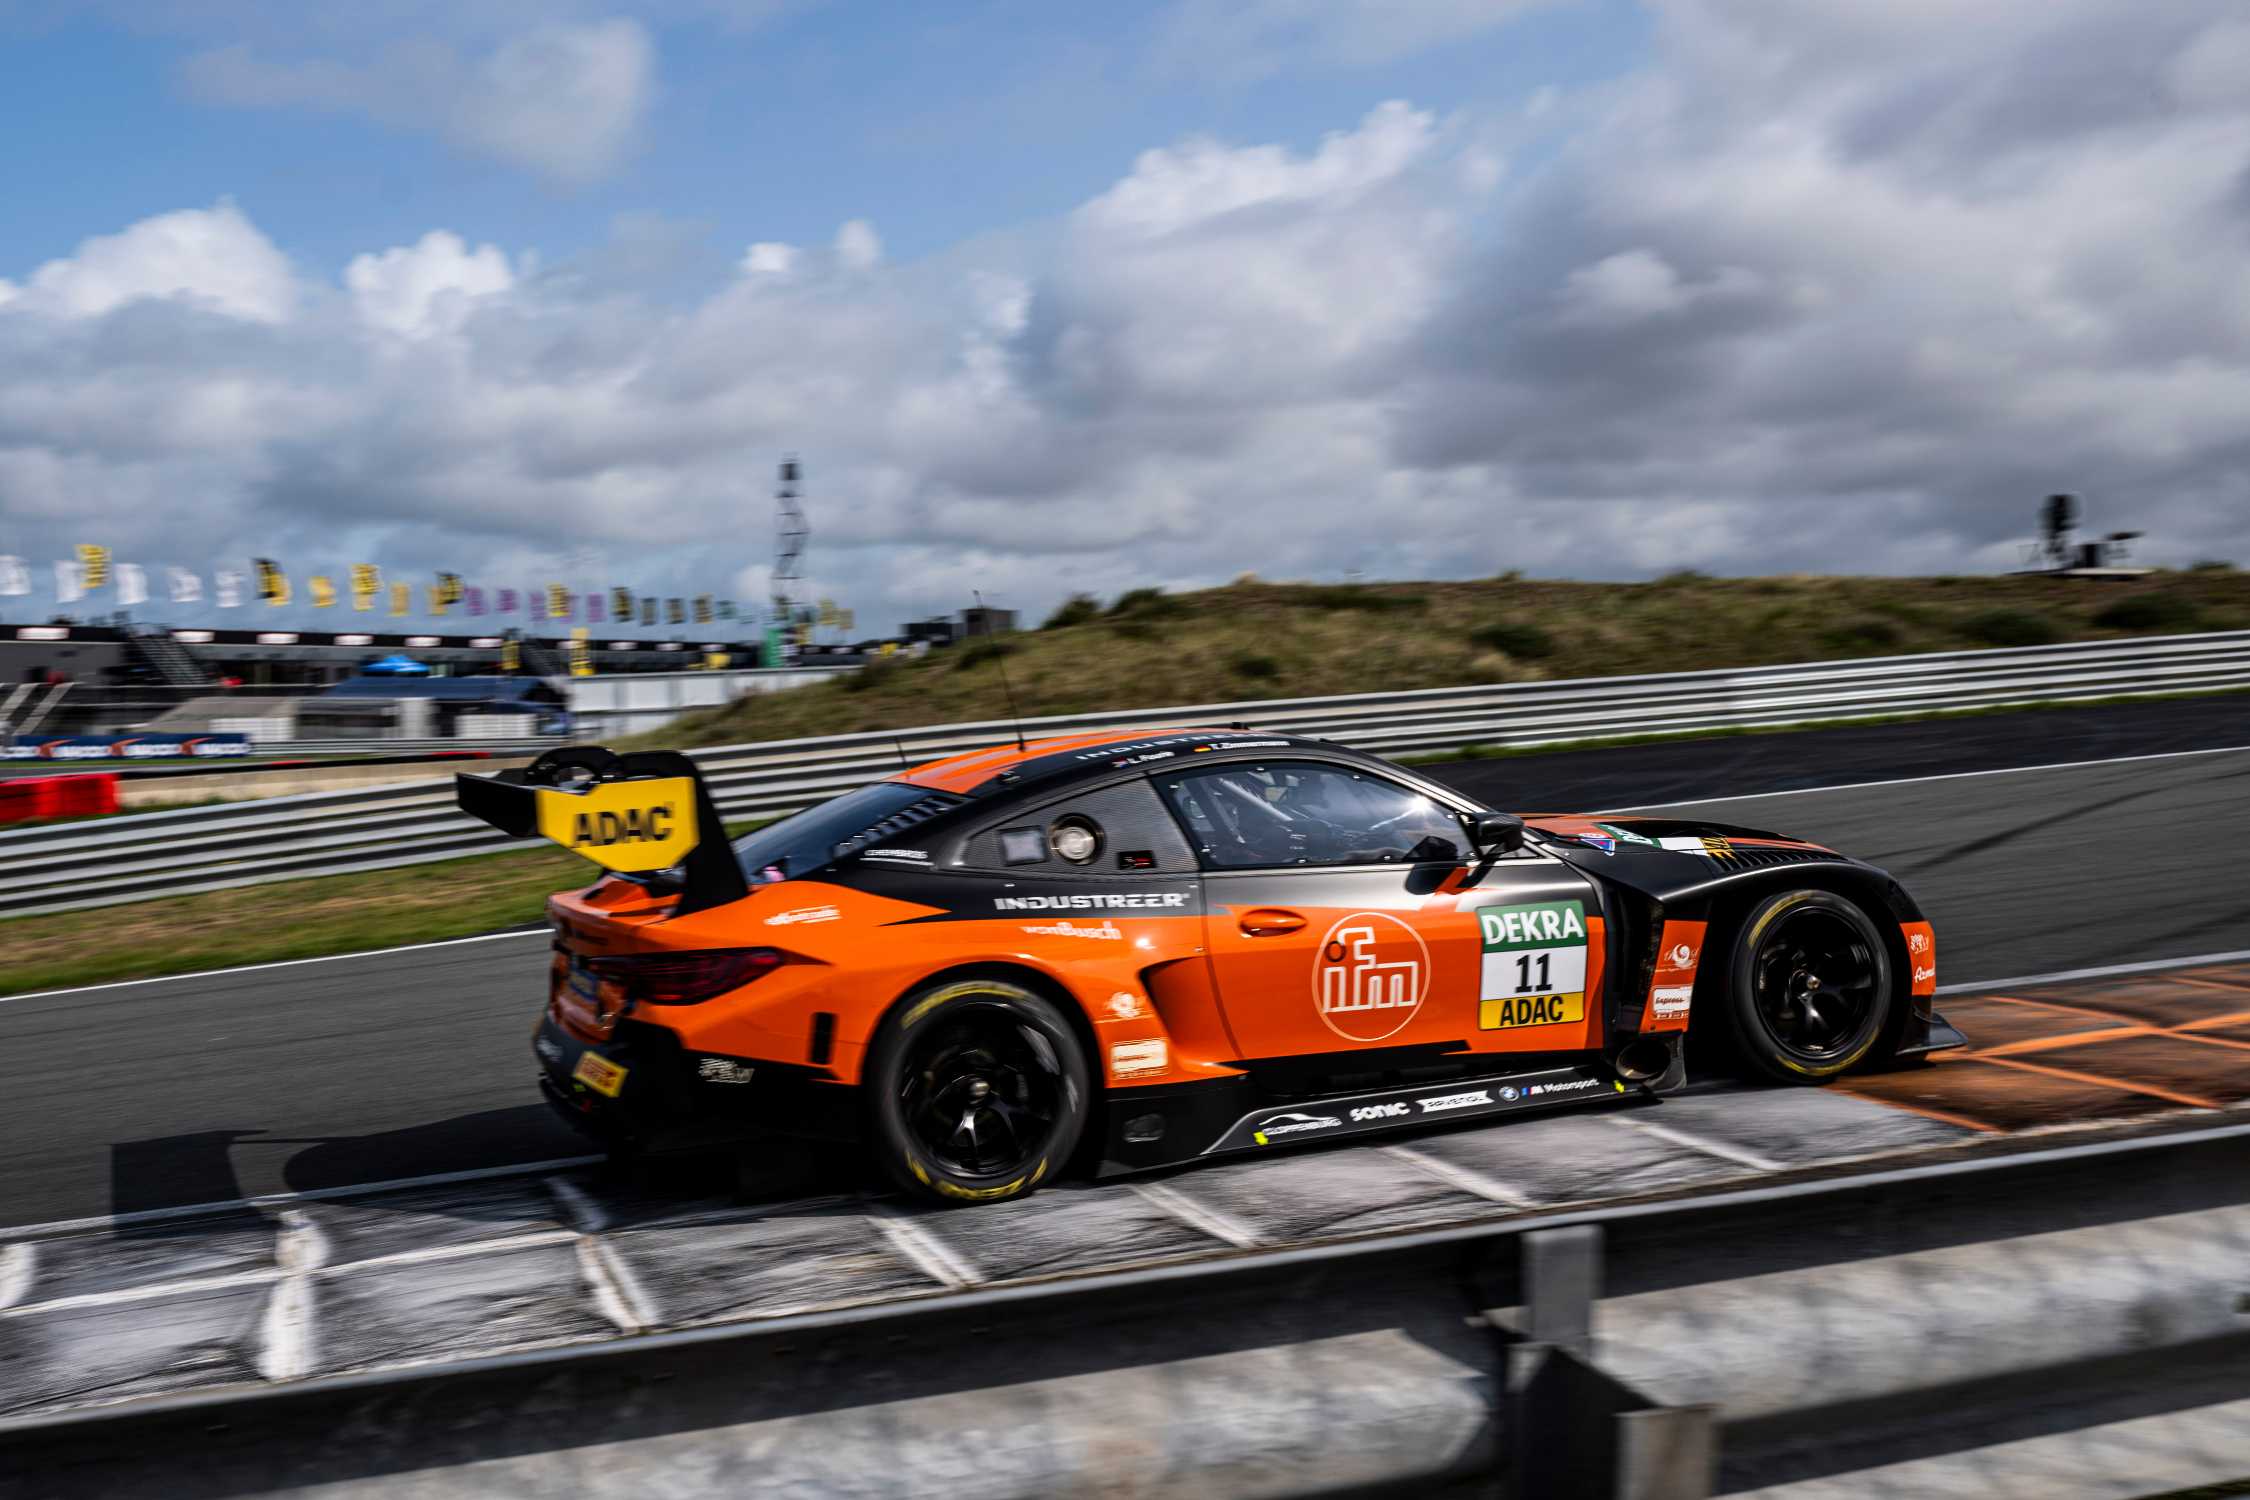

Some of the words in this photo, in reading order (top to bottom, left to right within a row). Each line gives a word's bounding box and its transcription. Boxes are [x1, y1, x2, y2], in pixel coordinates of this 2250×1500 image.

[574, 806, 673, 848] ADAC
[994, 893, 1185, 910] INDUSTREER
[1481, 907, 1585, 945] DEKRA
[1321, 926, 1418, 1013] ifm
[1515, 953, 1553, 993] 11
[1499, 995, 1564, 1027] ADAC
